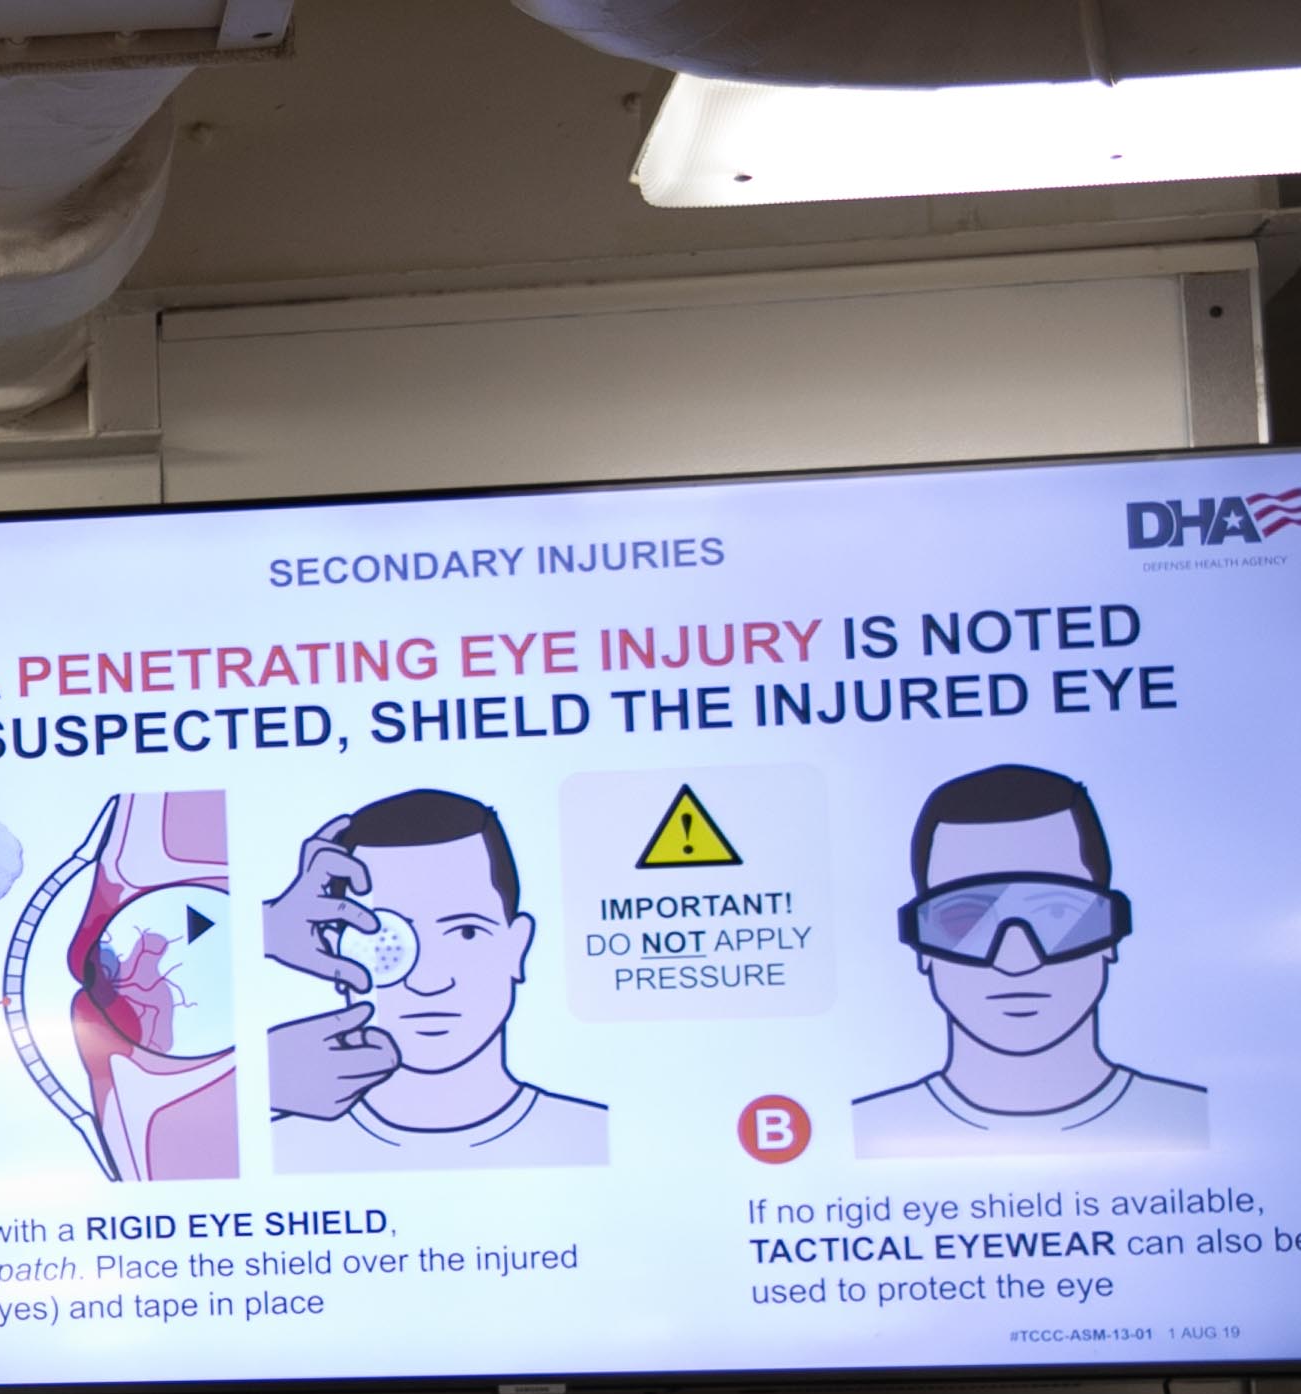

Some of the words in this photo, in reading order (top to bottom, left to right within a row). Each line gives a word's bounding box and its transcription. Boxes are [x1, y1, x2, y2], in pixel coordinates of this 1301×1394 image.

[1126, 496, 1262, 550] DHA
[268, 546, 525, 589] SECONDARY
[537, 536, 726, 575] INJURIES
[1142, 561, 1192, 573] DEFENSE
[1194, 557, 1239, 570] HEALTH
[1241, 555, 1289, 567] AGENCY
[17, 636, 439, 699] PENETRATING
[460, 630, 580, 679] EYE
[600, 617, 823, 672] INJURY
[843, 613, 900, 661] IS
[920, 602, 1142, 658] NOTED
[369, 692, 592, 745] SHIELD
[608, 684, 735, 734] THE
[754, 671, 1030, 728] INJURED
[1051, 663, 1179, 715] EYE
[600, 890, 794, 922] IMPORTANT!
[585, 931, 633, 958] DO
[641, 929, 707, 956] NOT
[712, 925, 813, 953] APPLY
[614, 962, 787, 992] PRESSURE
[754, 1107, 795, 1151] B
[57, 1222, 76, 1243] a
[85, 1213, 177, 1242] RIGID
[187, 1211, 255, 1239] EYE
[264, 1208, 397, 1238] SHIELD,
[748, 1197, 769, 1225] If
[776, 1203, 816, 1225] no
[825, 1194, 892, 1230] rigid
[902, 1199, 961, 1228] eye
[970, 1191, 1064, 1220] shield
[1074, 1190, 1101, 1217] is
[1110, 1185, 1265, 1217] available,
[96, 1253, 180, 1280] Place
[187, 1251, 236, 1279] the
[244, 1248, 333, 1277] shield
[342, 1253, 410, 1275] over
[417, 1246, 466, 1273] the
[475, 1242, 579, 1278] injured
[748, 1234, 926, 1265] TACTICAL
[934, 1229, 1117, 1261] EYEWEAR
[1126, 1234, 1185, 1257] can
[1195, 1226, 1264, 1255] also
[69, 1293, 124, 1320] and
[133, 1293, 199, 1325] tape
[208, 1290, 234, 1317] in
[244, 1289, 326, 1323] place
[751, 1276, 827, 1305] used
[836, 1276, 868, 1303] to
[877, 1273, 988, 1309] protect
[995, 1272, 1047, 1300] the
[1056, 1276, 1115, 1305] eye
[1009, 1327, 1153, 1343] #TCCC-ASM-13-01
[1168, 1327, 1175, 1339] 1
[1181, 1326, 1218, 1340] AUG
[1223, 1325, 1241, 1339] 19
